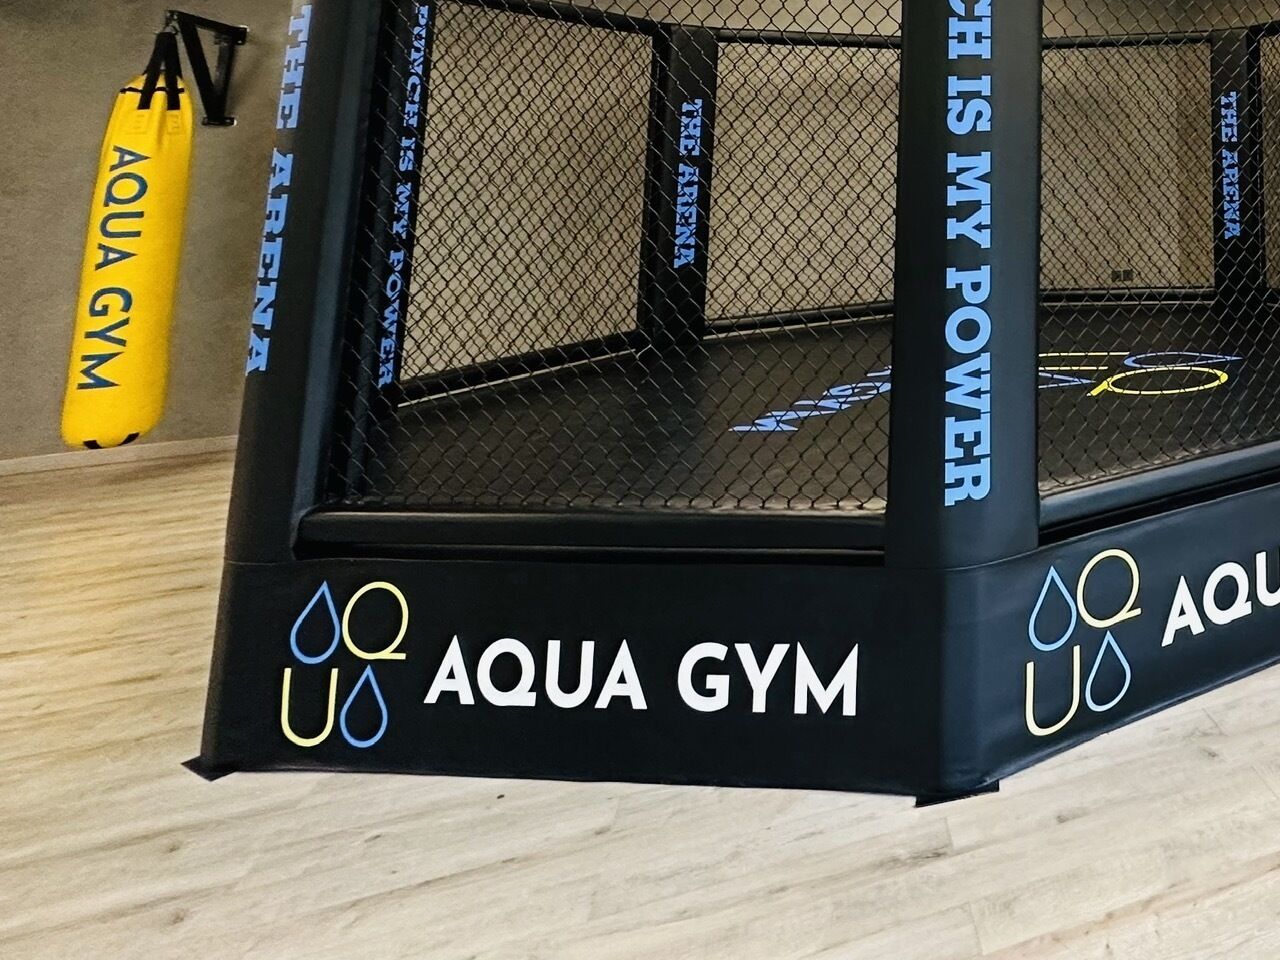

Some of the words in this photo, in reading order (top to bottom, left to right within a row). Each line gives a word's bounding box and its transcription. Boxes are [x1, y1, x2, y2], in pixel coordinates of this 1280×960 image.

[275, 4, 312, 130] THE
[403, 5, 430, 128] PUNCH
[946, 75, 992, 135] IS
[1220, 91, 1238, 143] THE
[398, 137, 416, 173] IS
[680, 98, 703, 156] THE
[95, 145, 150, 271] AQUA
[673, 163, 699, 269] ARENA
[946, 151, 992, 249] MY
[1221, 149, 1241, 240] ARENA
[245, 147, 294, 376] ARENA
[76, 286, 134, 390] GYM
[377, 250, 407, 389] POWER
[944, 265, 992, 507] POWER
[423, 634, 648, 710] AQUA
[677, 641, 859, 716] GYM
